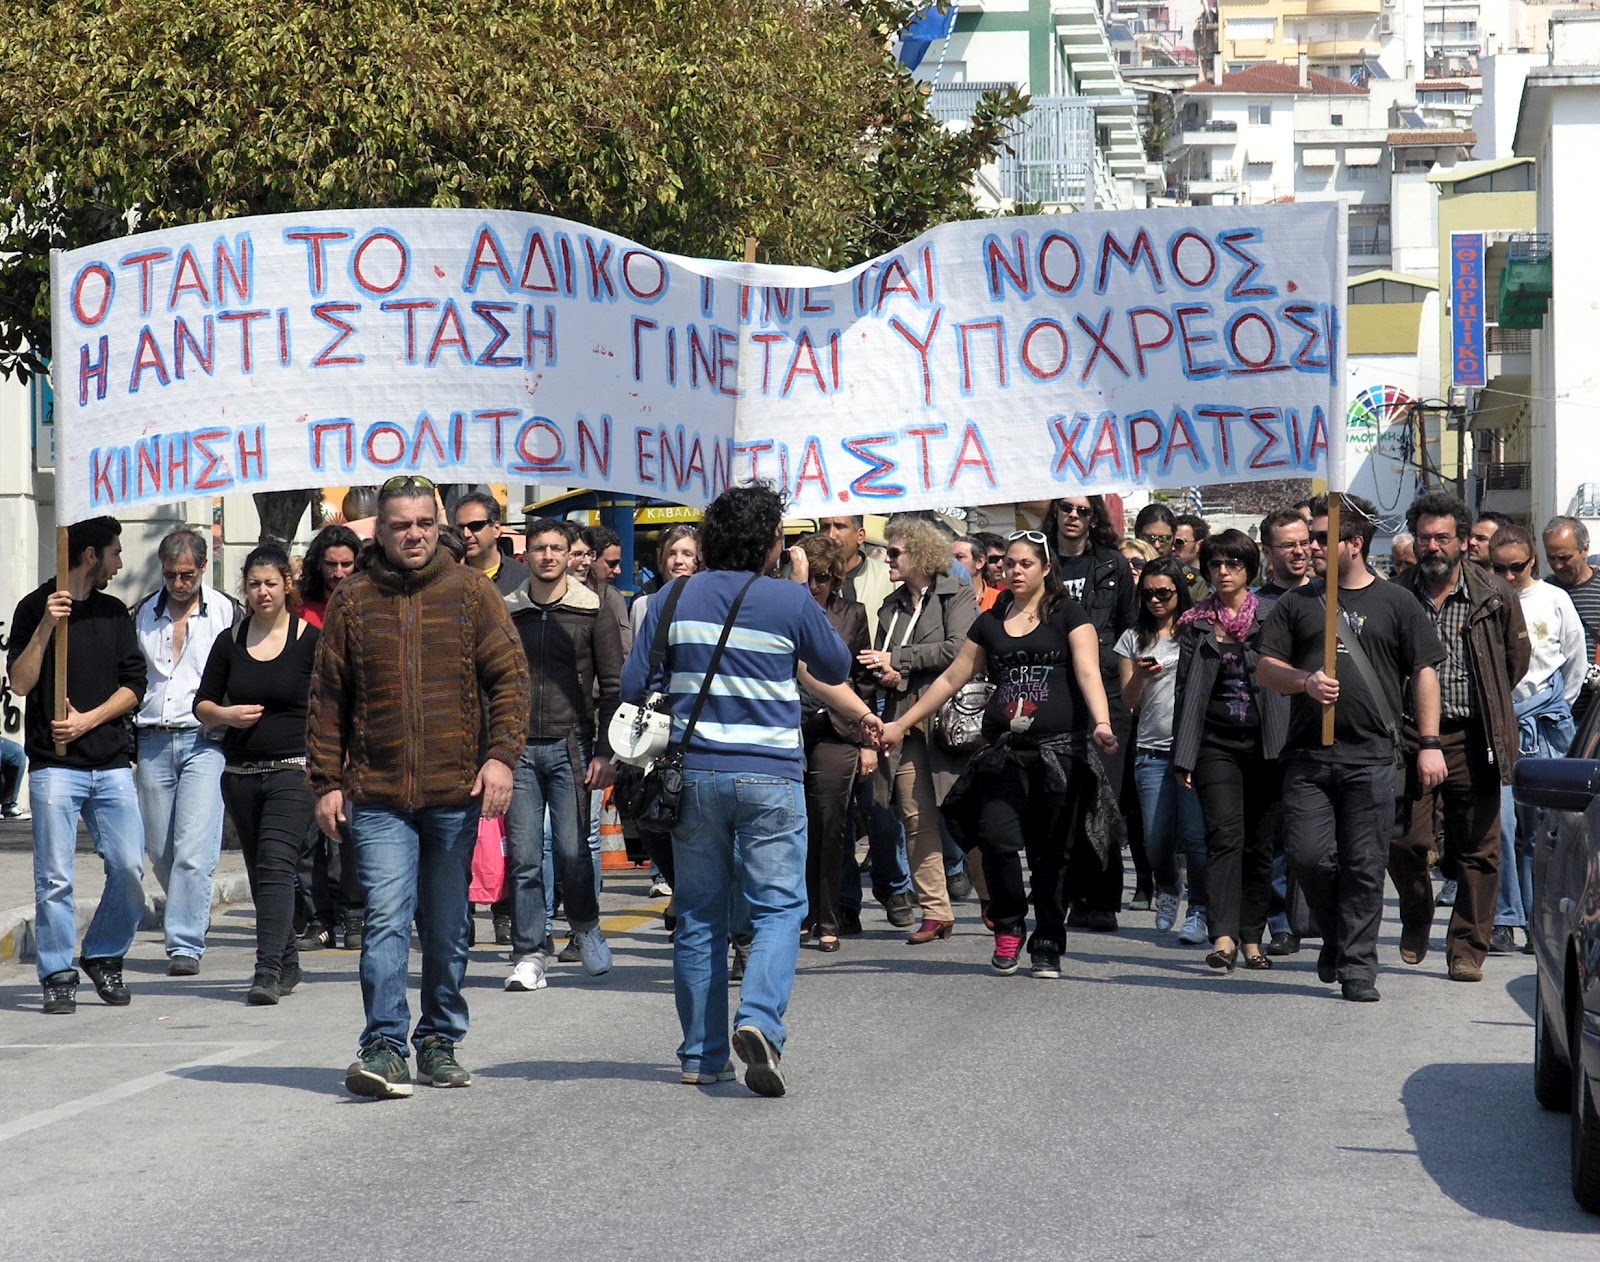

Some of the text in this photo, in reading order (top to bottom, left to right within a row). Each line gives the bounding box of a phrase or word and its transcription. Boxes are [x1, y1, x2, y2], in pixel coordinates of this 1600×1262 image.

[70, 230, 253, 327] ΟΤΑΝ
[282, 226, 412, 300] ΤΟ
[463, 222, 669, 304] ΑΔΙΚΟ
[1456, 248, 1480, 373] ΘΕΩΡΗΤΙΚΟ
[79, 334, 109, 407] Η
[128, 298, 556, 394] ΑΝΤΙΣΤΑΣΗ
[632, 314, 844, 398] ΓΙΝΕΤΑΙ
[89, 422, 267, 508] ΚΙΝΗΣΗ
[308, 408, 614, 487] ΠΟΛΙΤΩΝ
